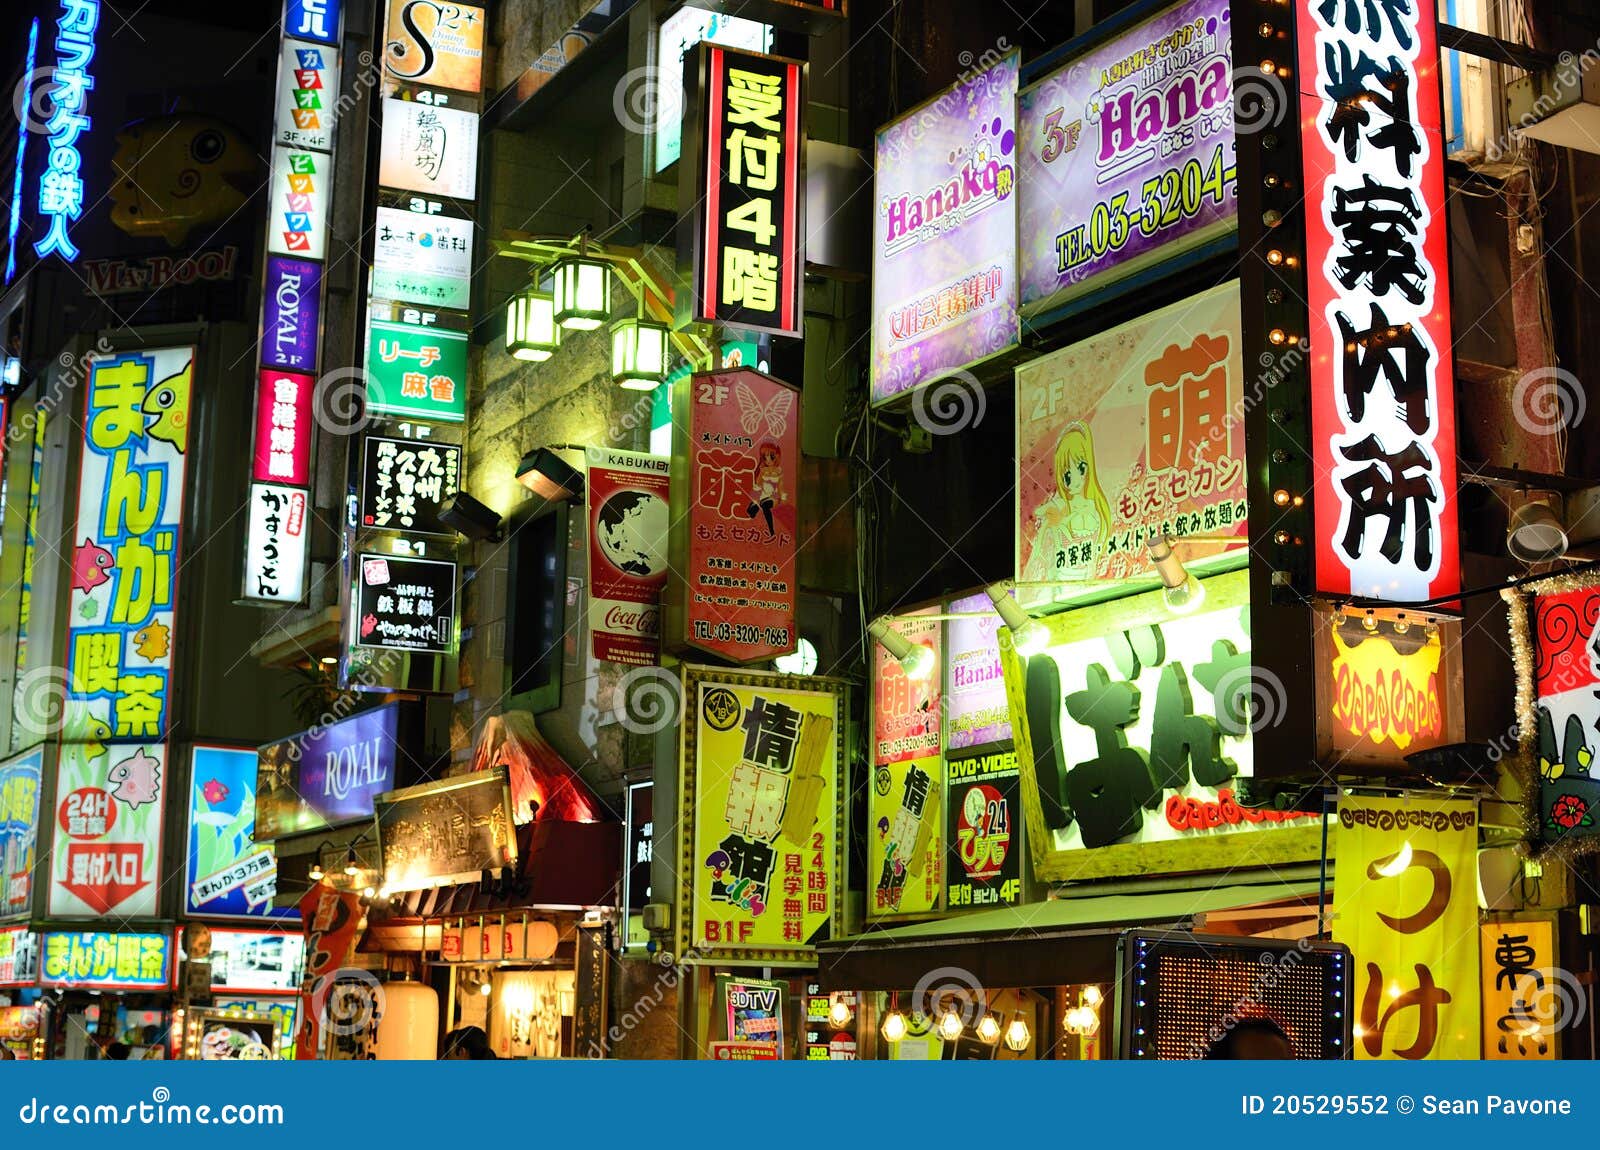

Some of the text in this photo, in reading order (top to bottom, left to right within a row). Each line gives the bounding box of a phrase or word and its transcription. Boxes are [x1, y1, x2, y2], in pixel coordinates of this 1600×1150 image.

[292, 49, 325, 130] カラオケ
[416, 91, 448, 106] 4F
[33, 0, 99, 262] カラオケの鉄人
[1042, 107, 1082, 163] 3F
[409, 197, 443, 215] 3F
[722, 68, 782, 313] 受付4階
[886, 158, 1000, 243] Hanako
[1056, 143, 1238, 273] TEL.03-3204-
[438, 235, 467, 253] 歯科
[276, 272, 301, 352] ROYAL
[403, 309, 437, 325] 2F
[275, 352, 303, 366] 2F
[379, 339, 441, 368] リーチ
[401, 372, 455, 403] 麻雀
[698, 383, 730, 406] 2F
[1030, 378, 1065, 422] 2F
[1145, 332, 1231, 474] 萌
[398, 423, 431, 440] 1F
[415, 448, 445, 503] 九州
[696, 448, 758, 521] 萌
[1117, 454, 1248, 522] もえセカン
[72, 360, 173, 737] まんが喫茶
[257, 489, 289, 597] かすうどん
[696, 525, 792, 548] もえセカンド
[377, 595, 434, 617] 鉄板鍋
[324, 736, 387, 800] ROYAL
[67, 793, 109, 817] 24H
[987, 798, 1008, 835] 24
[68, 815, 106, 836] 営業
[72, 853, 138, 886] 受付入口
[807, 832, 828, 914] 24時間
[783, 853, 804, 943] 見学無料
[949, 879, 1020, 906] 受付 当ビル 4F
[705, 919, 756, 943] B1F
[46, 933, 165, 979] まんが喫茶
[1360, 847, 1453, 1060] つけ
[731, 989, 777, 1012] 3DTV
[808, 984, 819, 995] 6F
